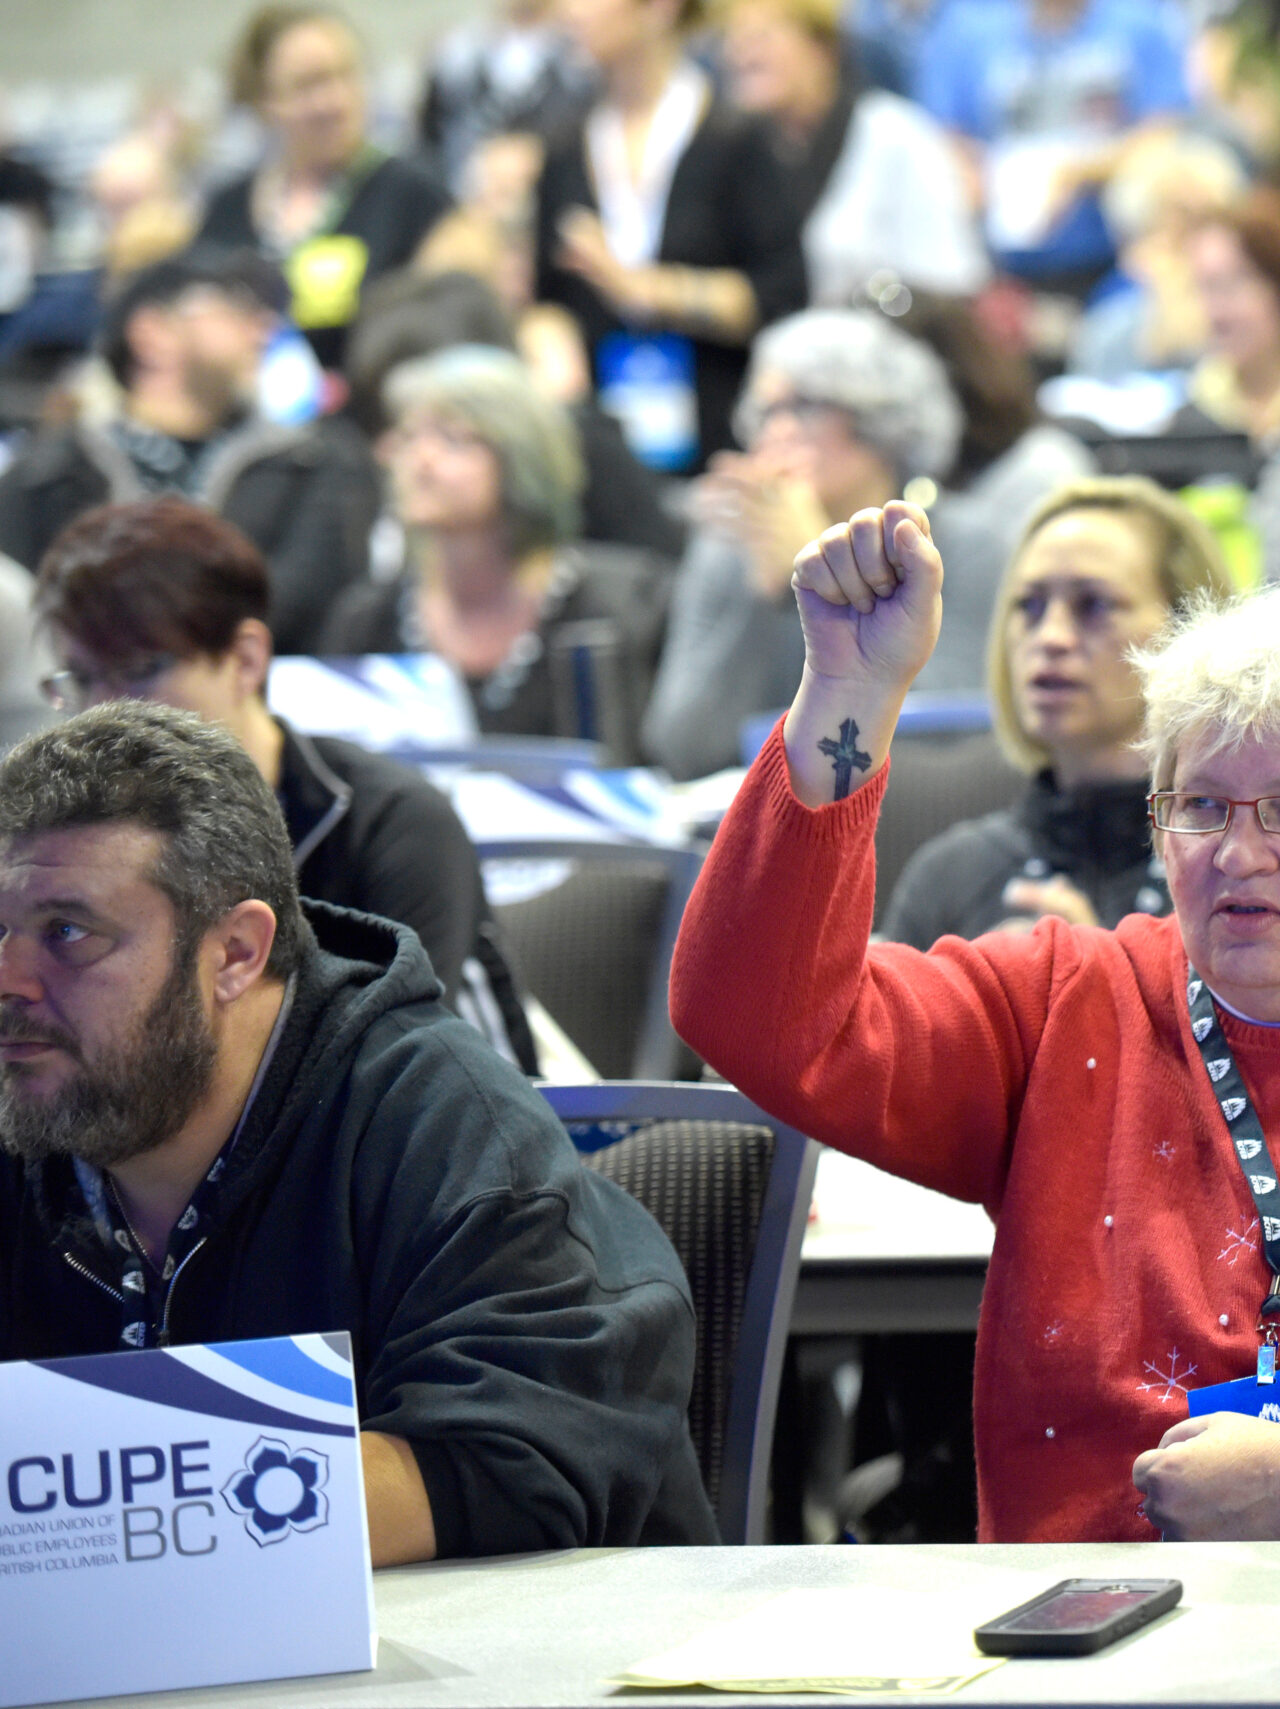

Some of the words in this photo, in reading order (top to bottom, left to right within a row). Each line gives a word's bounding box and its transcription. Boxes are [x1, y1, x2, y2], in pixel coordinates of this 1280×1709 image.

[1221, 1100, 1234, 1121] BCFED
[1262, 1216, 1272, 1242] BCFED
[8, 1441, 213, 1513] CUPE
[49, 1517, 94, 1532] UNION
[97, 1514, 115, 1527] OF
[123, 1501, 218, 1562] BC
[35, 1534, 117, 1553] EMPLOYEES
[45, 1552, 118, 1571] COLUMBIA
